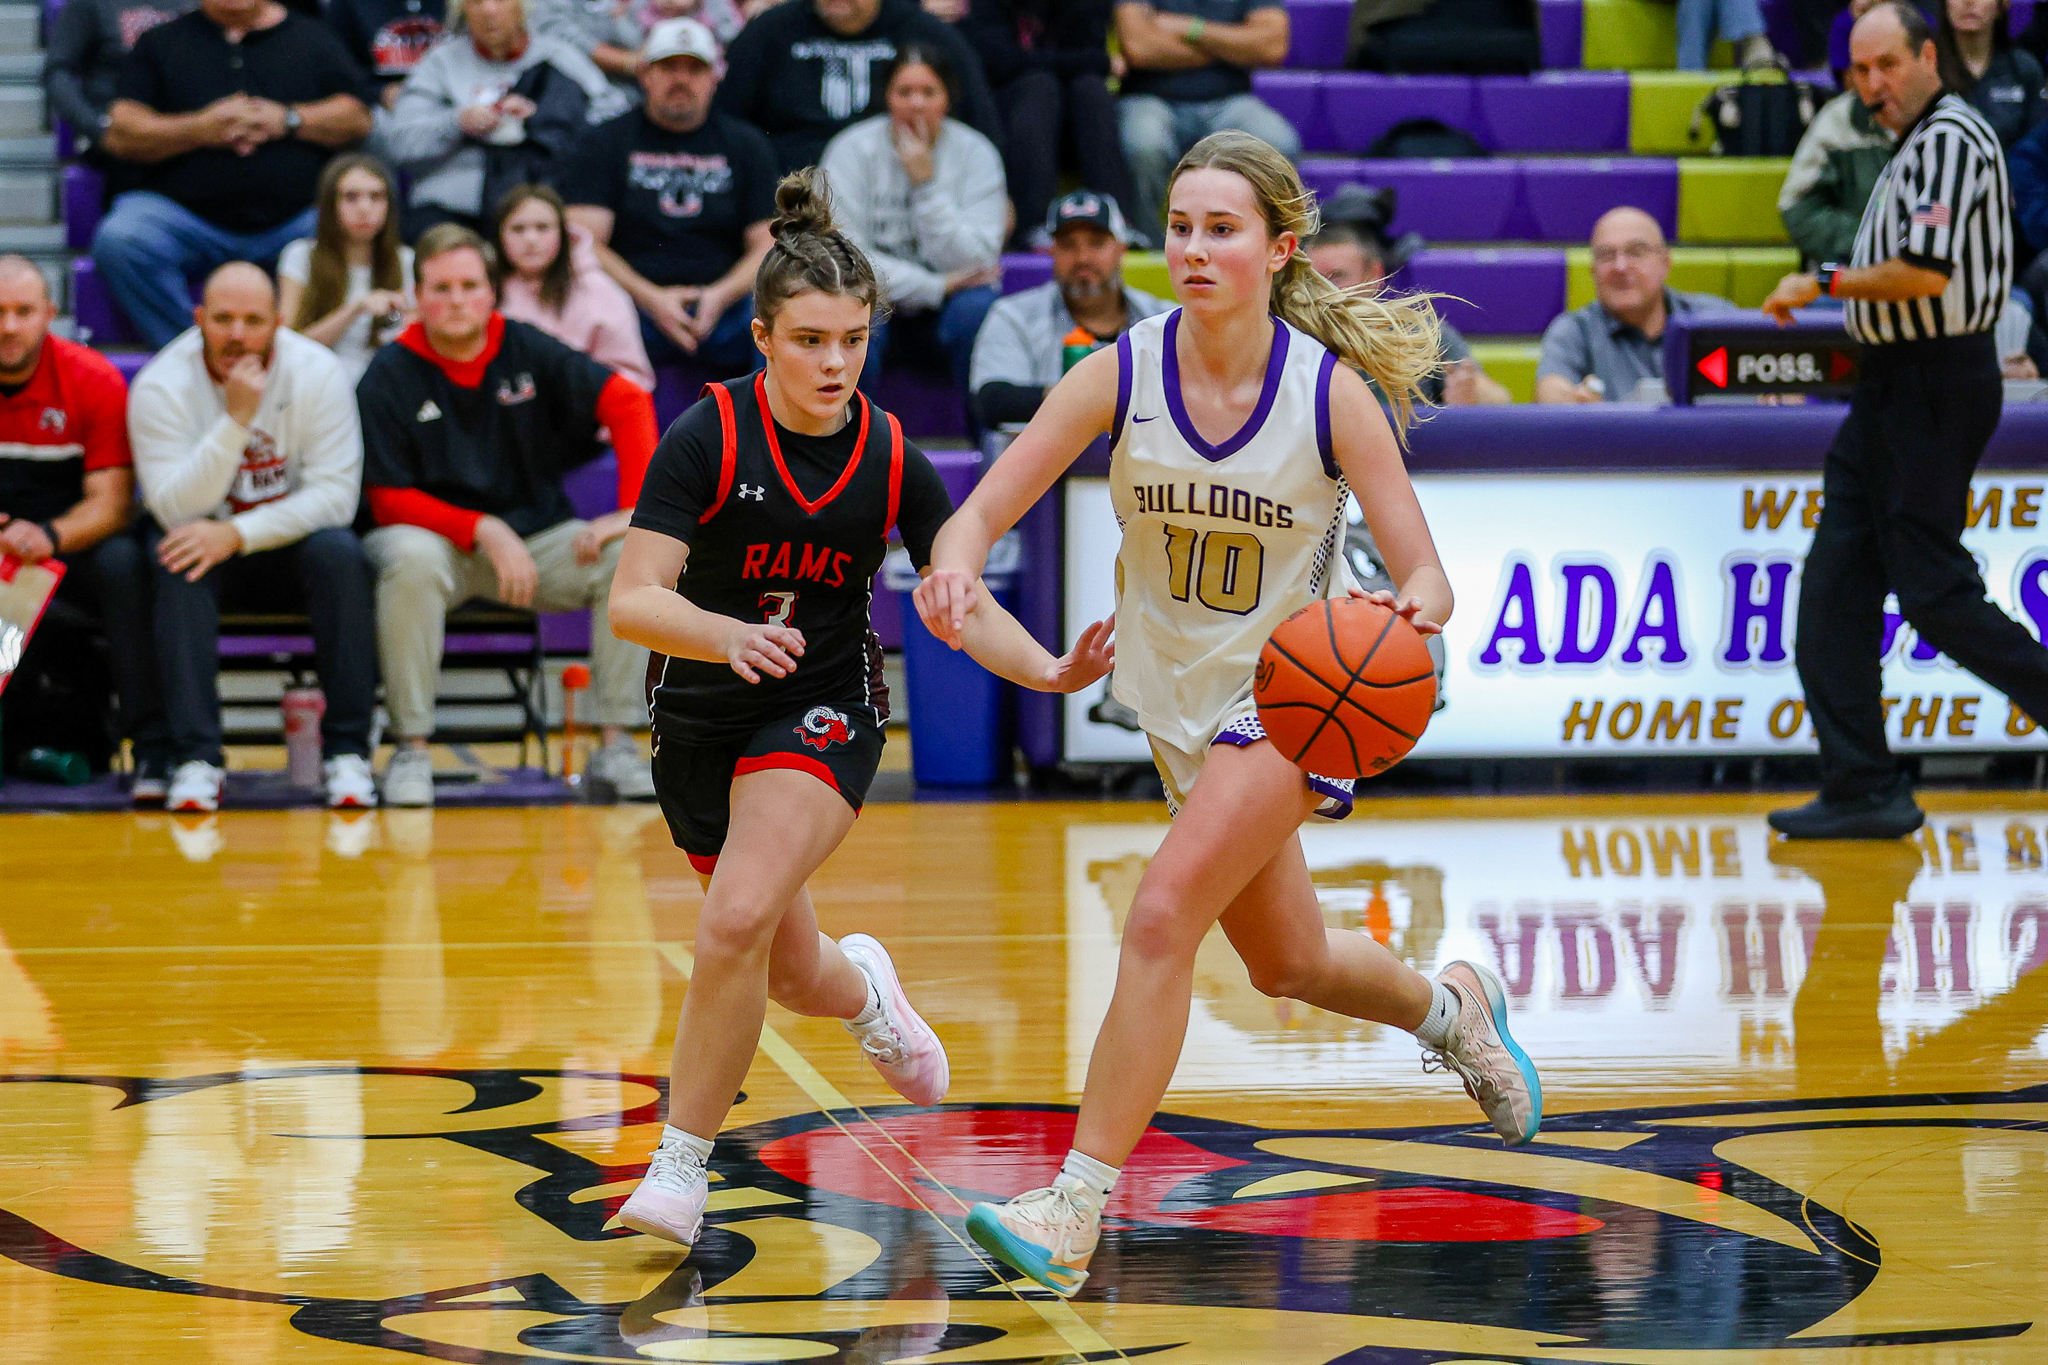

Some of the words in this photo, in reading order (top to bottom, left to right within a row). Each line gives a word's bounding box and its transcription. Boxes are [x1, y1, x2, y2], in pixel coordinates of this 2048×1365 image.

[1737, 353, 1823, 384] POSS.
[1134, 483, 1293, 528] BULLDOGS
[1743, 488, 2044, 529] WEME
[742, 542, 852, 588] RAMS
[1162, 521, 1264, 616] 10
[1480, 561, 1688, 664] ADA
[1563, 699, 1743, 741] HOME
[1769, 698, 1819, 739] O
